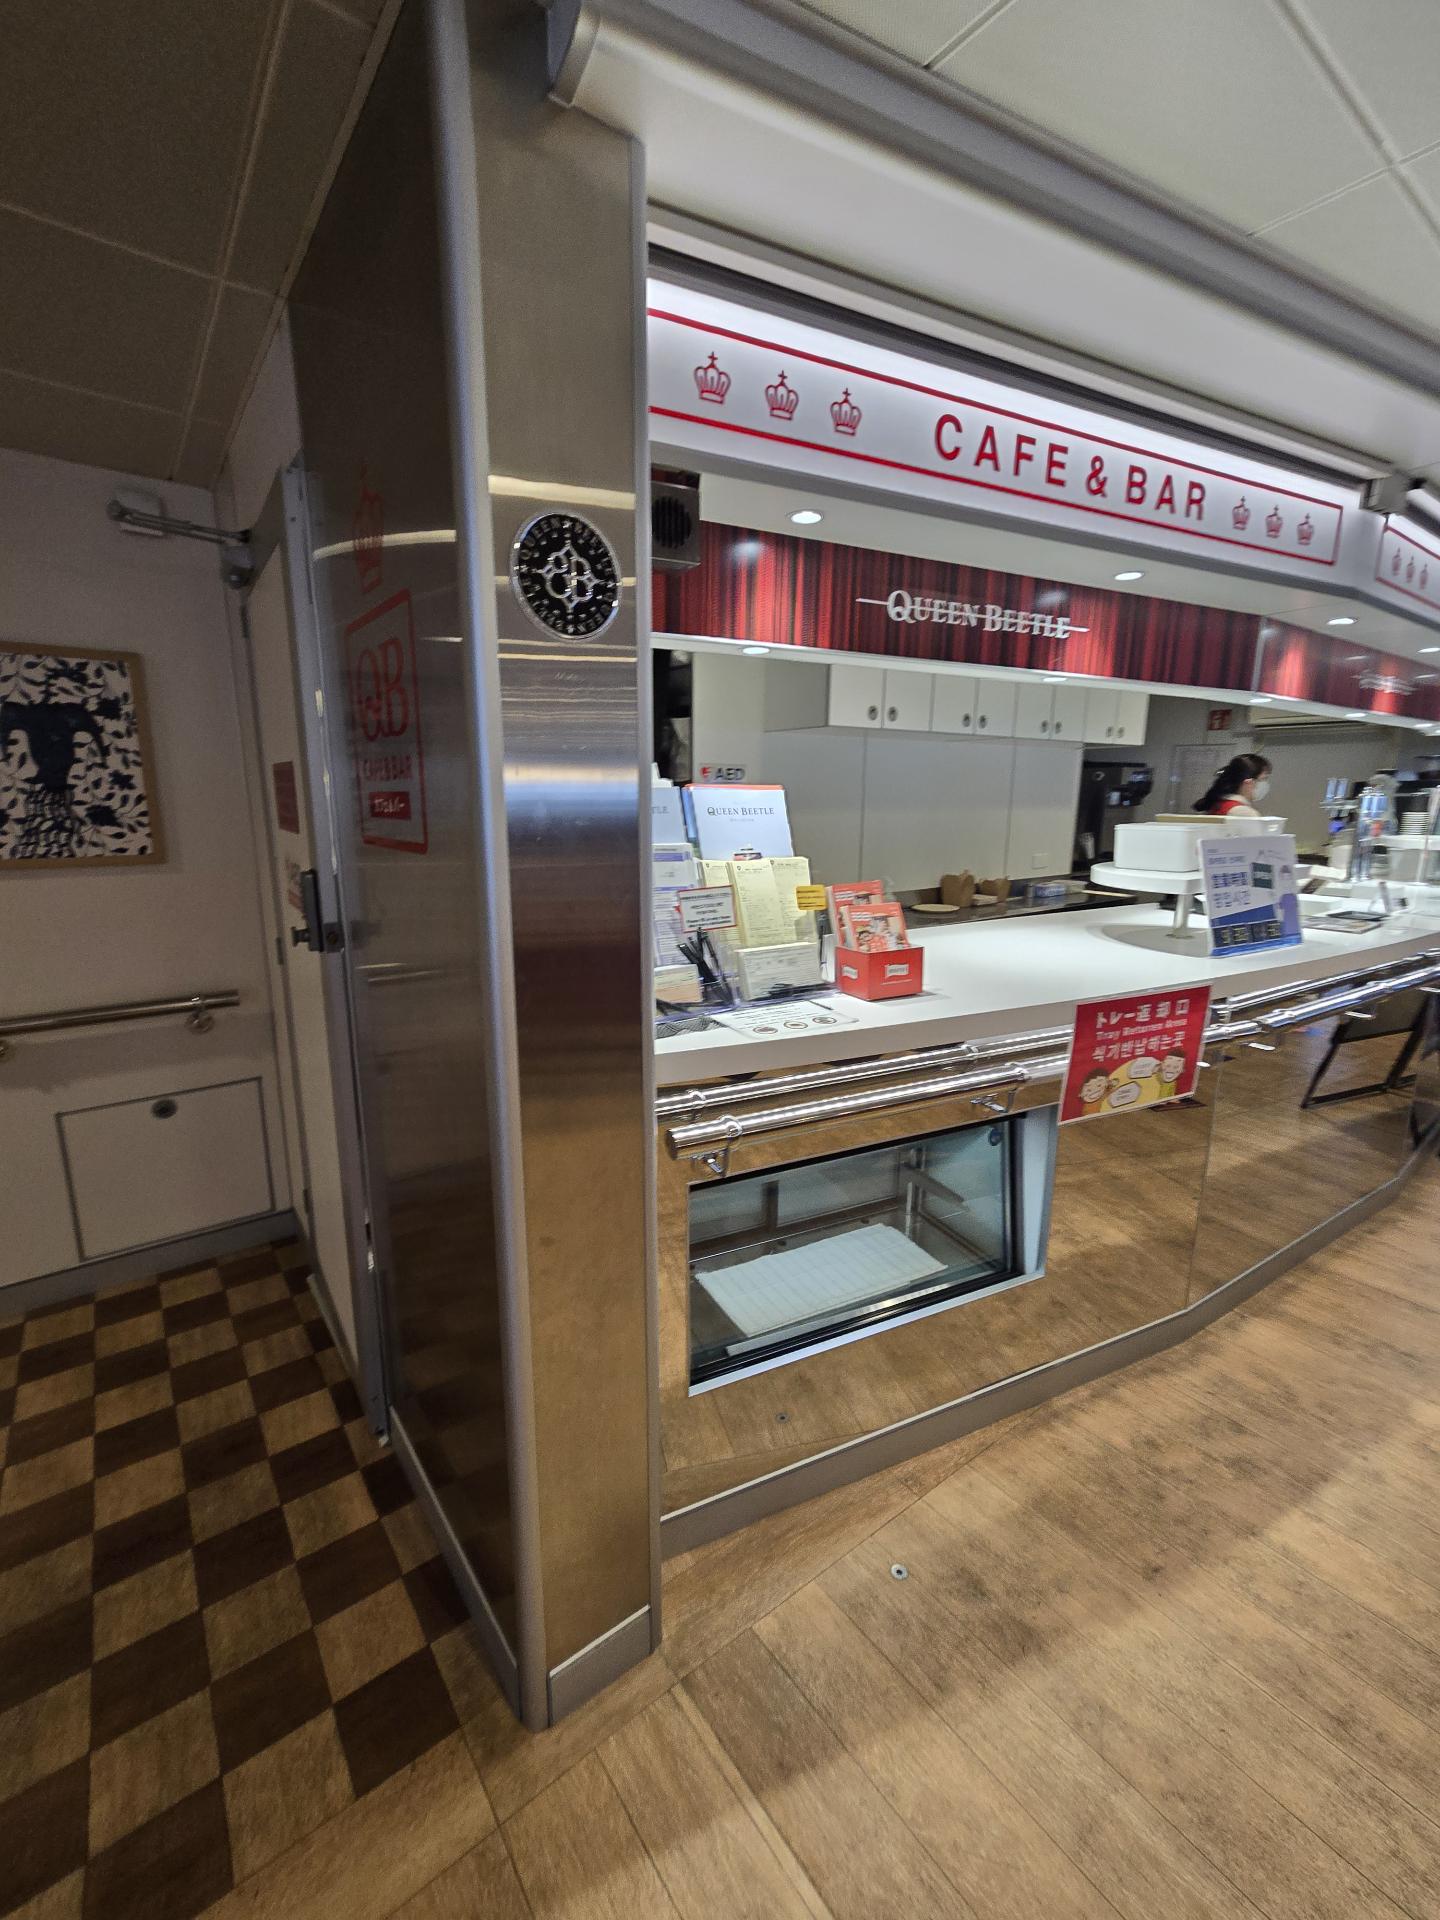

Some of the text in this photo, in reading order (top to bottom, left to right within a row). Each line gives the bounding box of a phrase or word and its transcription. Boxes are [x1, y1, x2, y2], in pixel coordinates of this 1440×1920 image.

[935, 414, 1206, 520] CAFE & BAR
[887, 589, 1072, 639] QUEEN BEETLE
[715, 766, 746, 781] AED
[707, 806, 774, 816] QUEEN BEETLE
